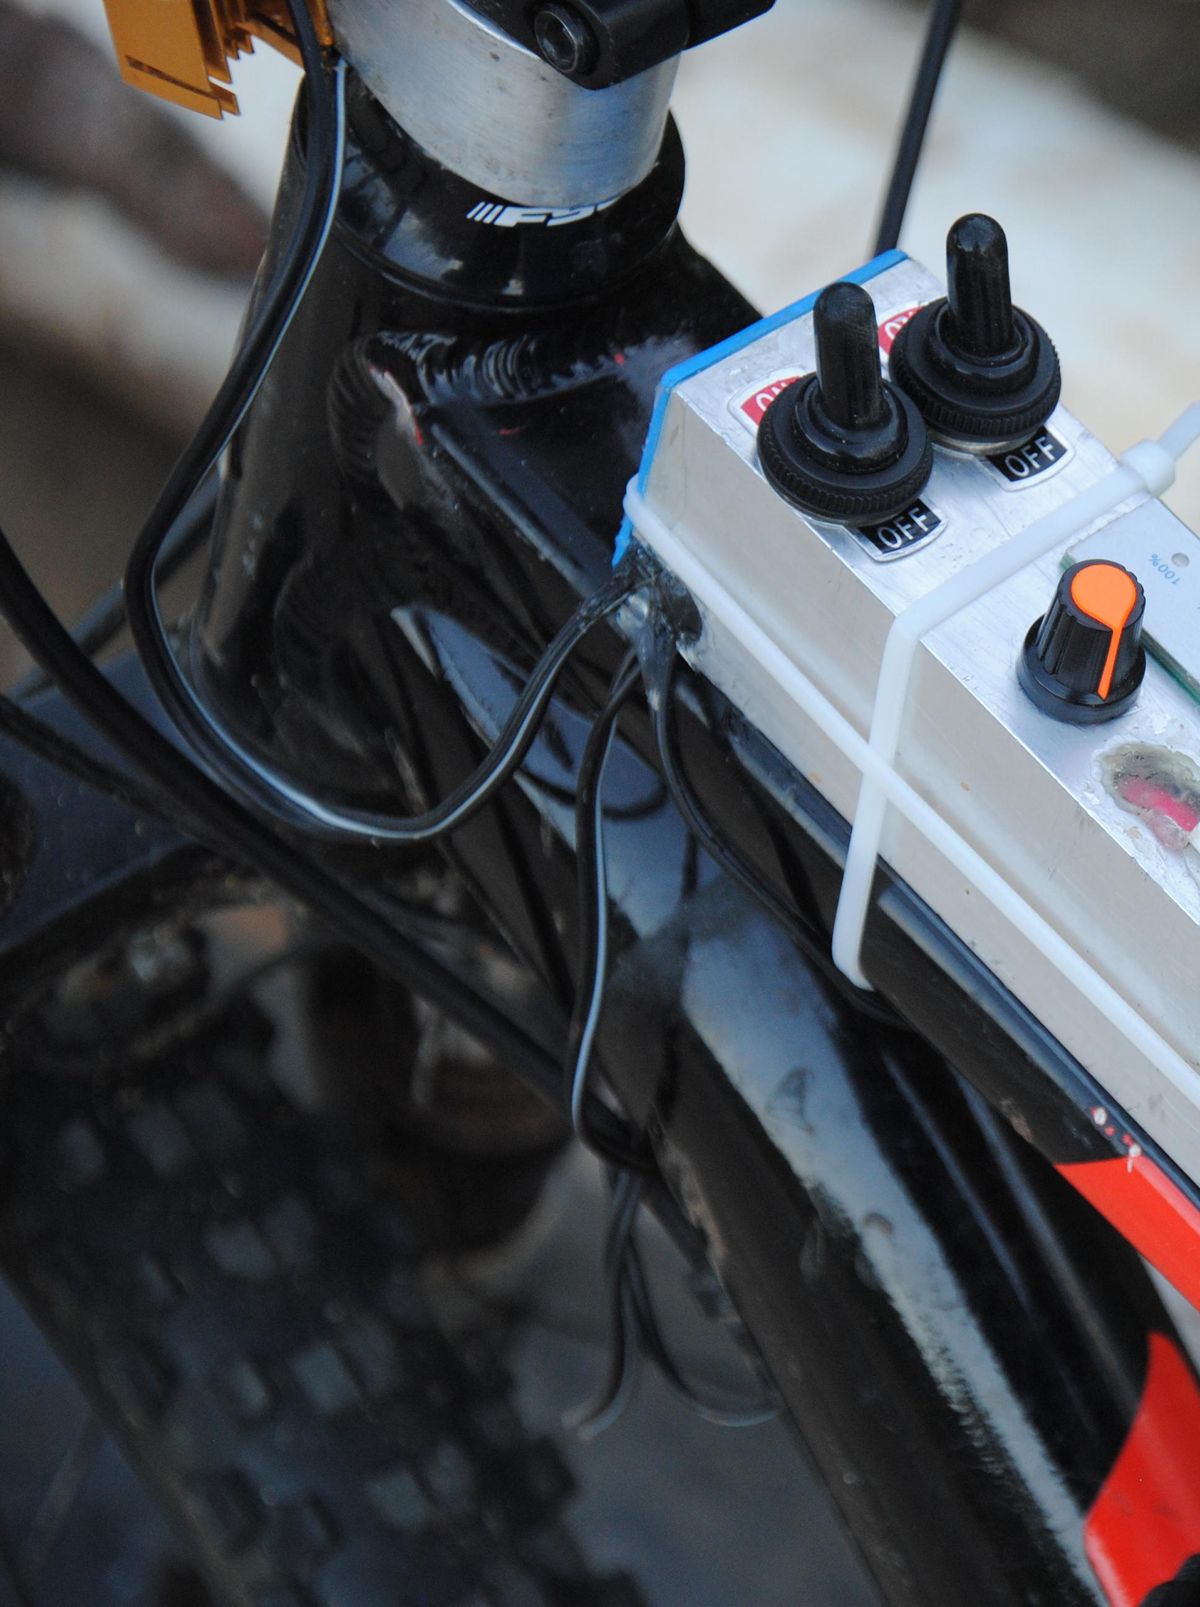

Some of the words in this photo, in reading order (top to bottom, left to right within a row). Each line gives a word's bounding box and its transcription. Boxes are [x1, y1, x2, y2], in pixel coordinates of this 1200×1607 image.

[1004, 437, 1058, 478] OFF
[877, 507, 933, 549] OFF
[1150, 552, 1182, 586] 100%
